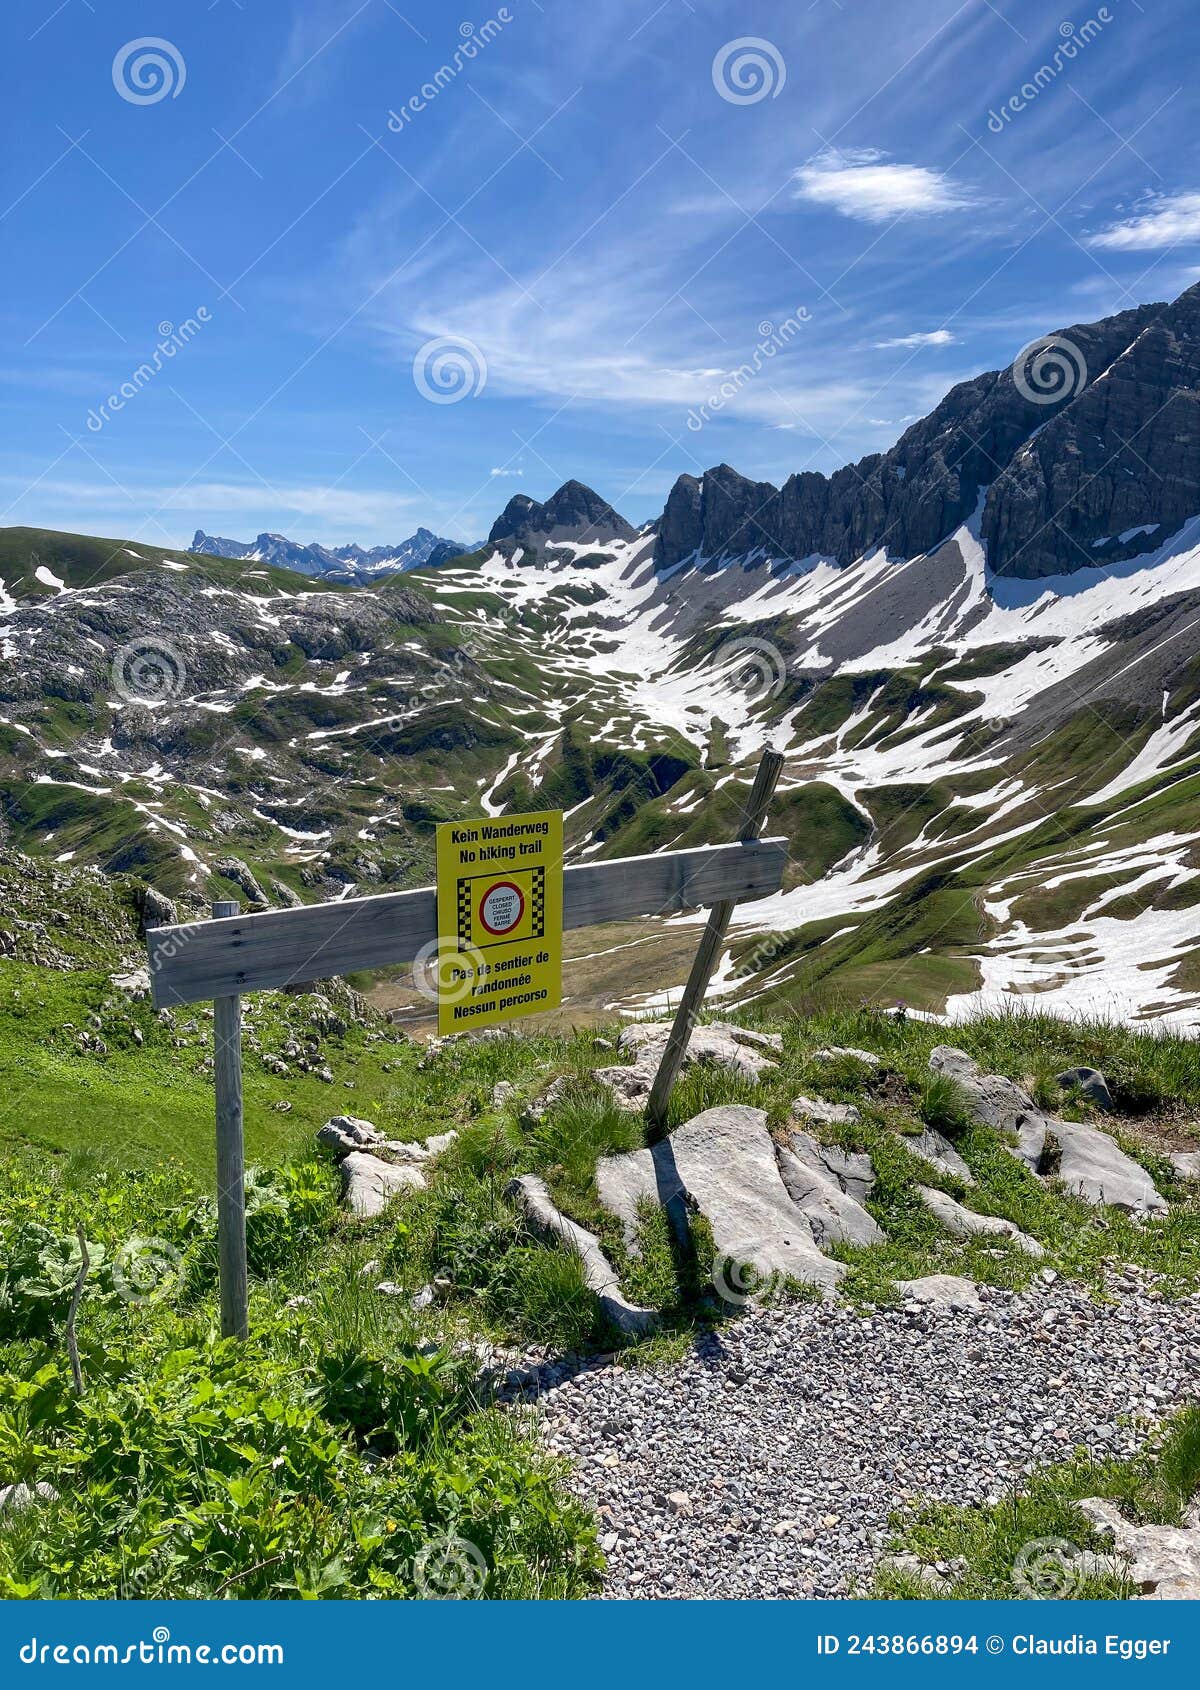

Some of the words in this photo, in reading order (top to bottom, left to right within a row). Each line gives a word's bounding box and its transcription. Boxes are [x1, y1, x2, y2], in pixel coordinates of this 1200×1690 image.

[452, 829, 479, 844] Kein
[481, 822, 549, 840] Wanderweg
[460, 850, 476, 864] No
[480, 845, 516, 861] hiking
[519, 840, 542, 855] trail
[492, 902, 513, 910] CLOSED
[452, 968, 474, 981] Pas
[477, 963, 491, 976] de
[494, 955, 533, 973] sentier
[536, 951, 549, 964] de
[471, 974, 531, 997] randonnée
[454, 1000, 496, 1019] Nessun
[499, 989, 548, 1011] percorso
